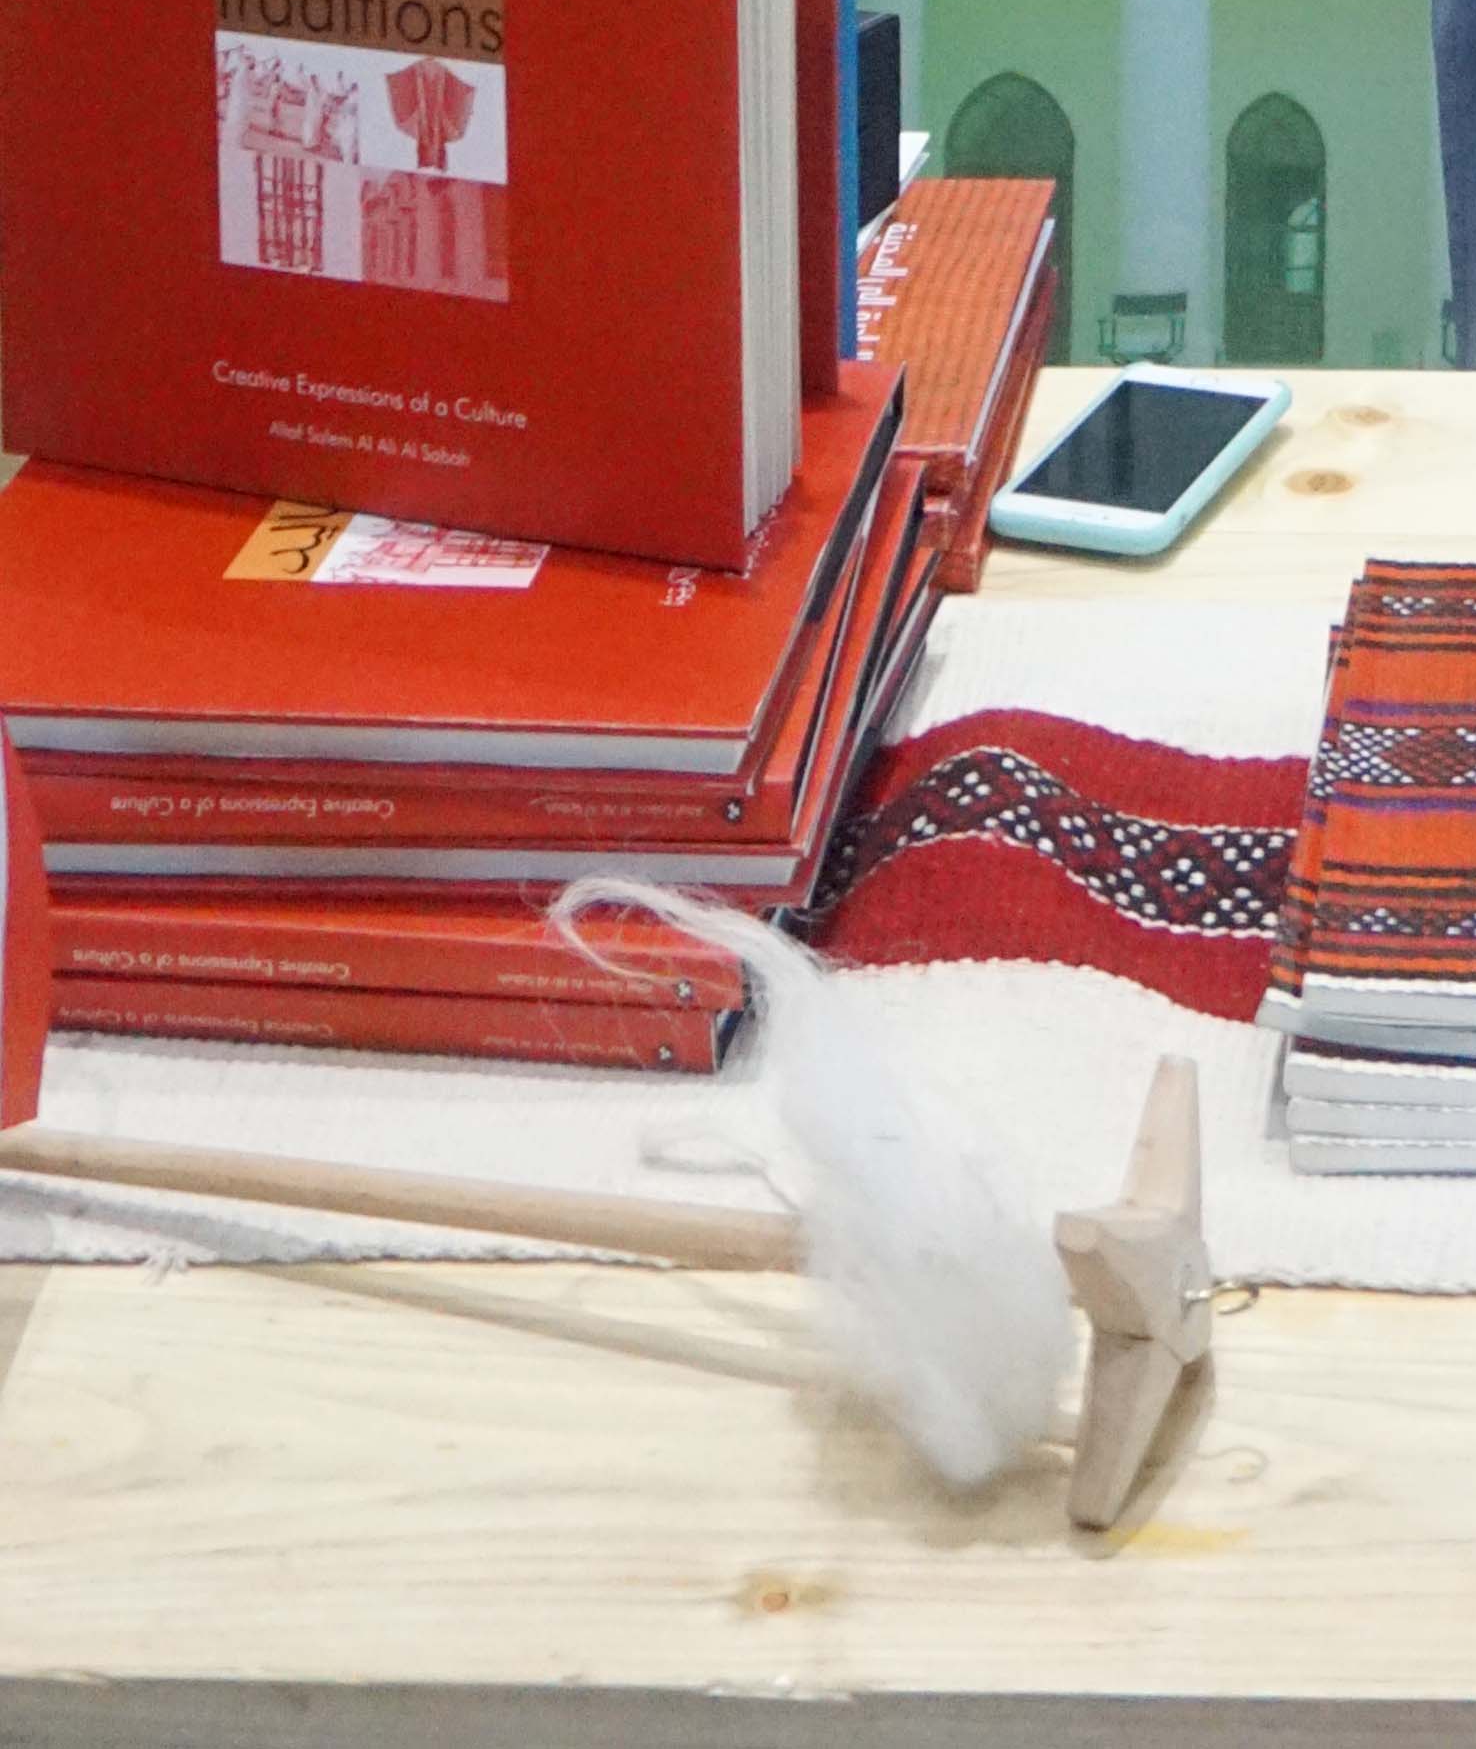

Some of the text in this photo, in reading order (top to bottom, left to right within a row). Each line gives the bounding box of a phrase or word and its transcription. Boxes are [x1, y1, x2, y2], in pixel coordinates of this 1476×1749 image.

[212, 359, 528, 430] Creative Expressions of a Culture
[179, 797, 192, 810] a
[195, 796, 215, 818] of
